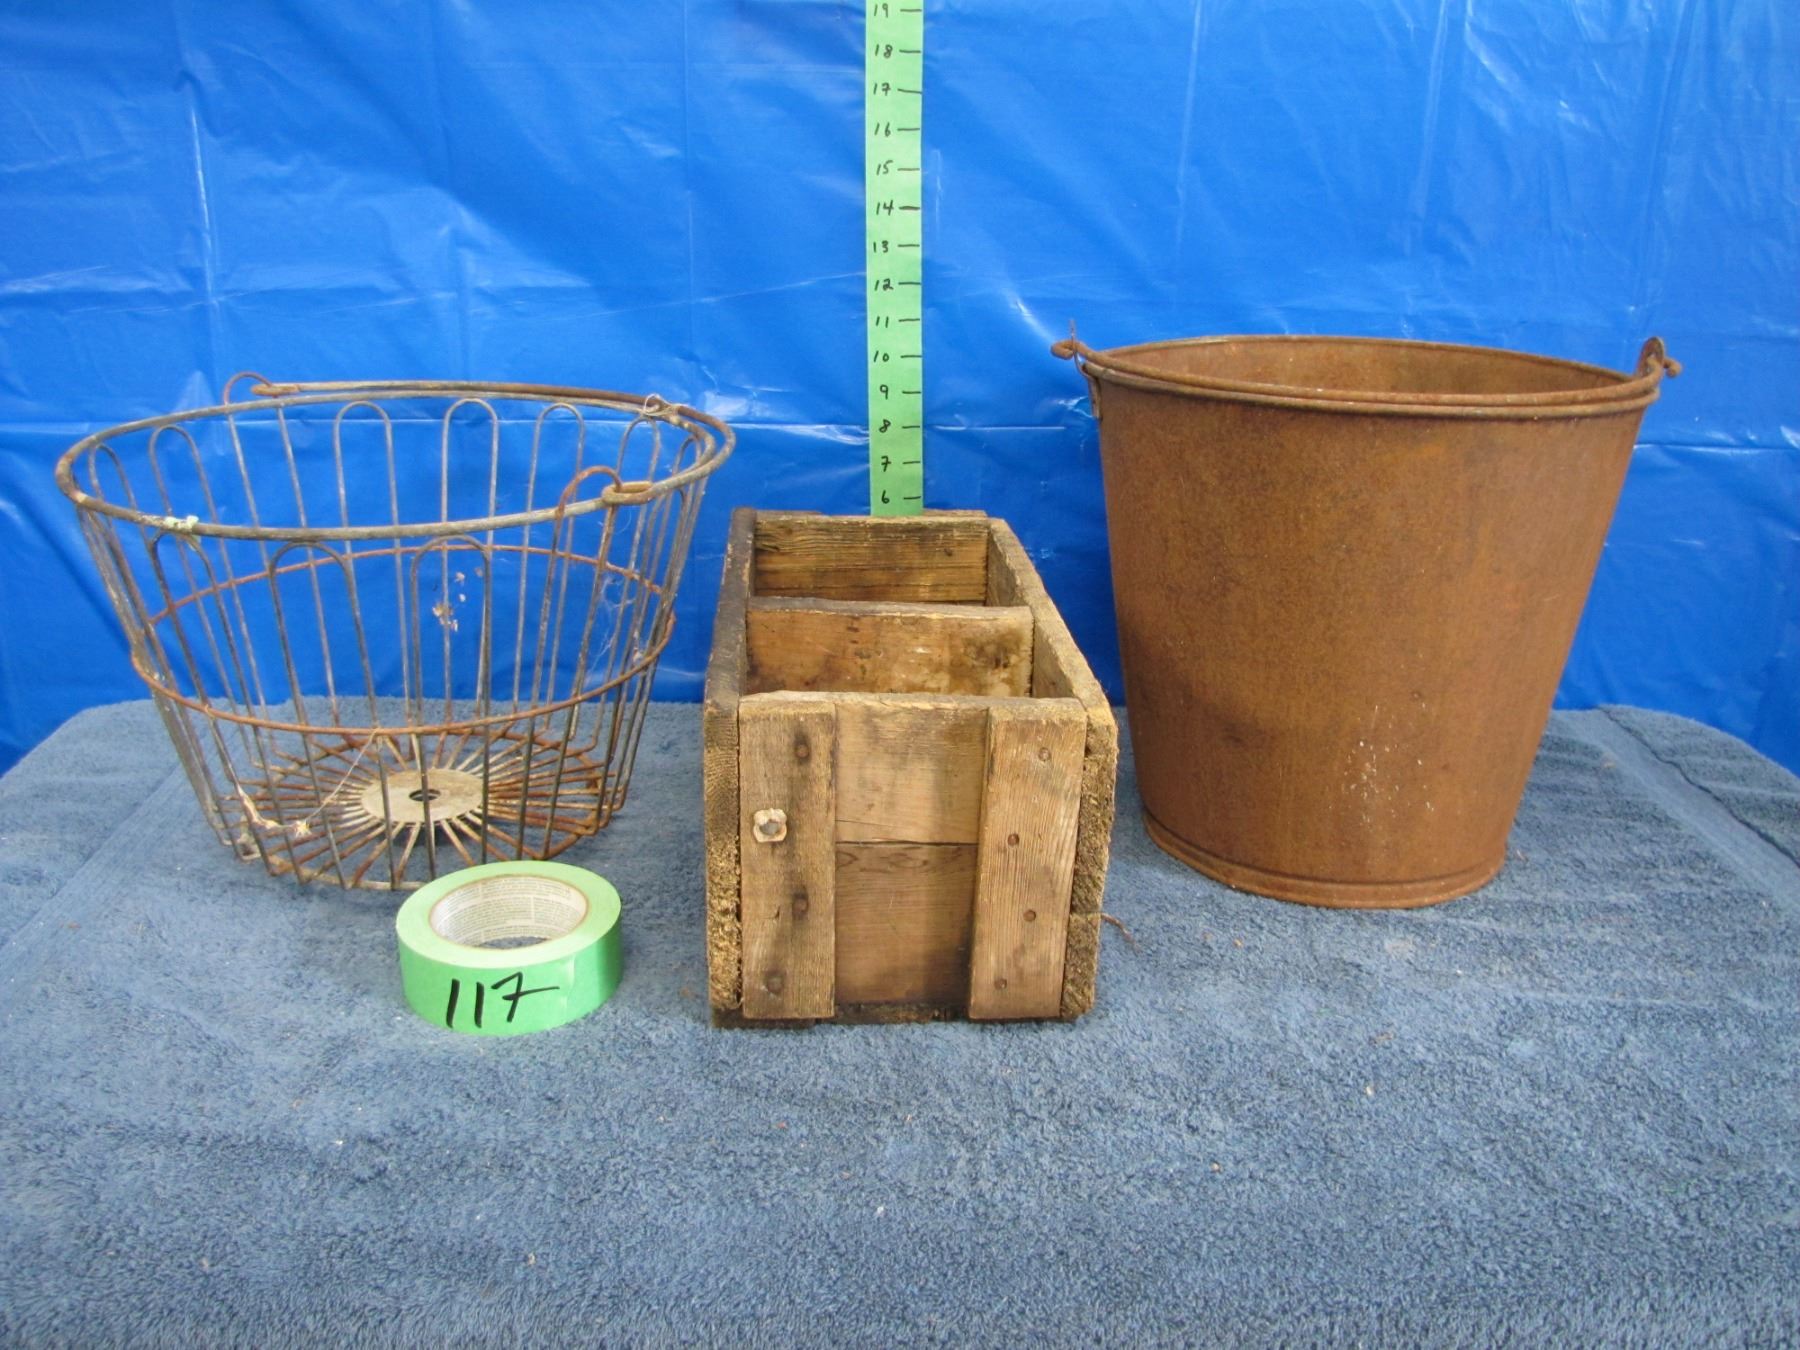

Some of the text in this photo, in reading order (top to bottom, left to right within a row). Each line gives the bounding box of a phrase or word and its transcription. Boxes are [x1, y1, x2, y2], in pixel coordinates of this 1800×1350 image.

[874, 3, 889, 18] 19
[875, 44, 893, 58] 18
[873, 83, 891, 96] 17
[874, 122, 891, 136] 16
[877, 160, 893, 175] 15
[876, 199, 894, 215] 14
[873, 240, 889, 253] 13
[874, 279, 893, 291] 12
[876, 316, 889, 328] 11
[874, 350, 889, 362] 10
[880, 384, 889, 399] 9
[879, 419, 891, 433] 8
[881, 456, 892, 472] 7
[881, 490, 890, 504] 6
[446, 971, 560, 1029] 117
